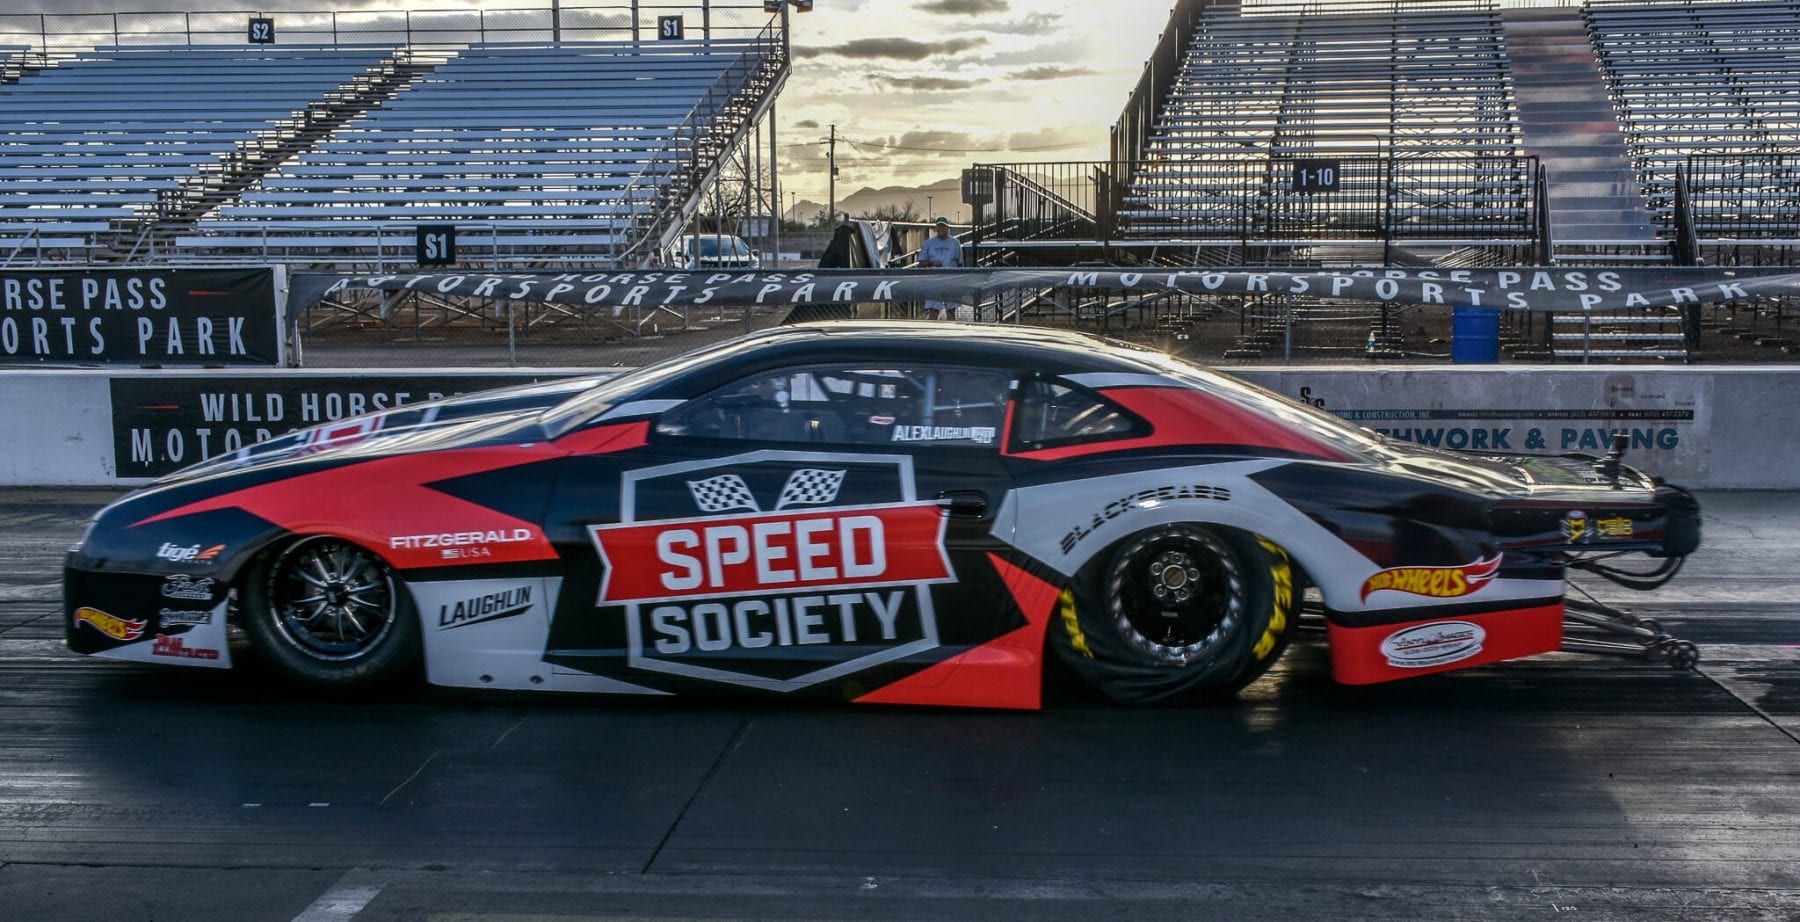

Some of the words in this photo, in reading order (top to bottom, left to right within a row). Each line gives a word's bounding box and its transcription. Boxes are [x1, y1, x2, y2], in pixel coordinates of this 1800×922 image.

[253, 23, 269, 40] S2
[663, 20, 678, 36] S1
[1300, 168, 1333, 186] 1-10
[425, 233, 447, 259] S1
[705, 273, 815, 285] PASS
[1317, 271, 1473, 283] ORSE
[1499, 271, 1622, 291] PASS
[4, 278, 66, 310] RSE
[82, 278, 167, 310] PASS
[755, 280, 900, 303] PARK
[1067, 272, 1528, 309] MOTORSPORTS
[1579, 283, 1749, 310] PARK
[2, 316, 105, 355] ORTS
[137, 316, 247, 355] PARK
[201, 392, 284, 422] WILD
[1525, 428, 1547, 450] &
[1561, 427, 1679, 450] PAVNG
[1059, 485, 1231, 555] BLACKBEARD
[389, 528, 532, 549] FITZGERALD
[157, 542, 201, 562] tigé
[461, 547, 492, 558] USA
[656, 515, 887, 591] SPEED
[439, 585, 532, 627] LAUGHLIN
[652, 590, 905, 654] SOCIETY
